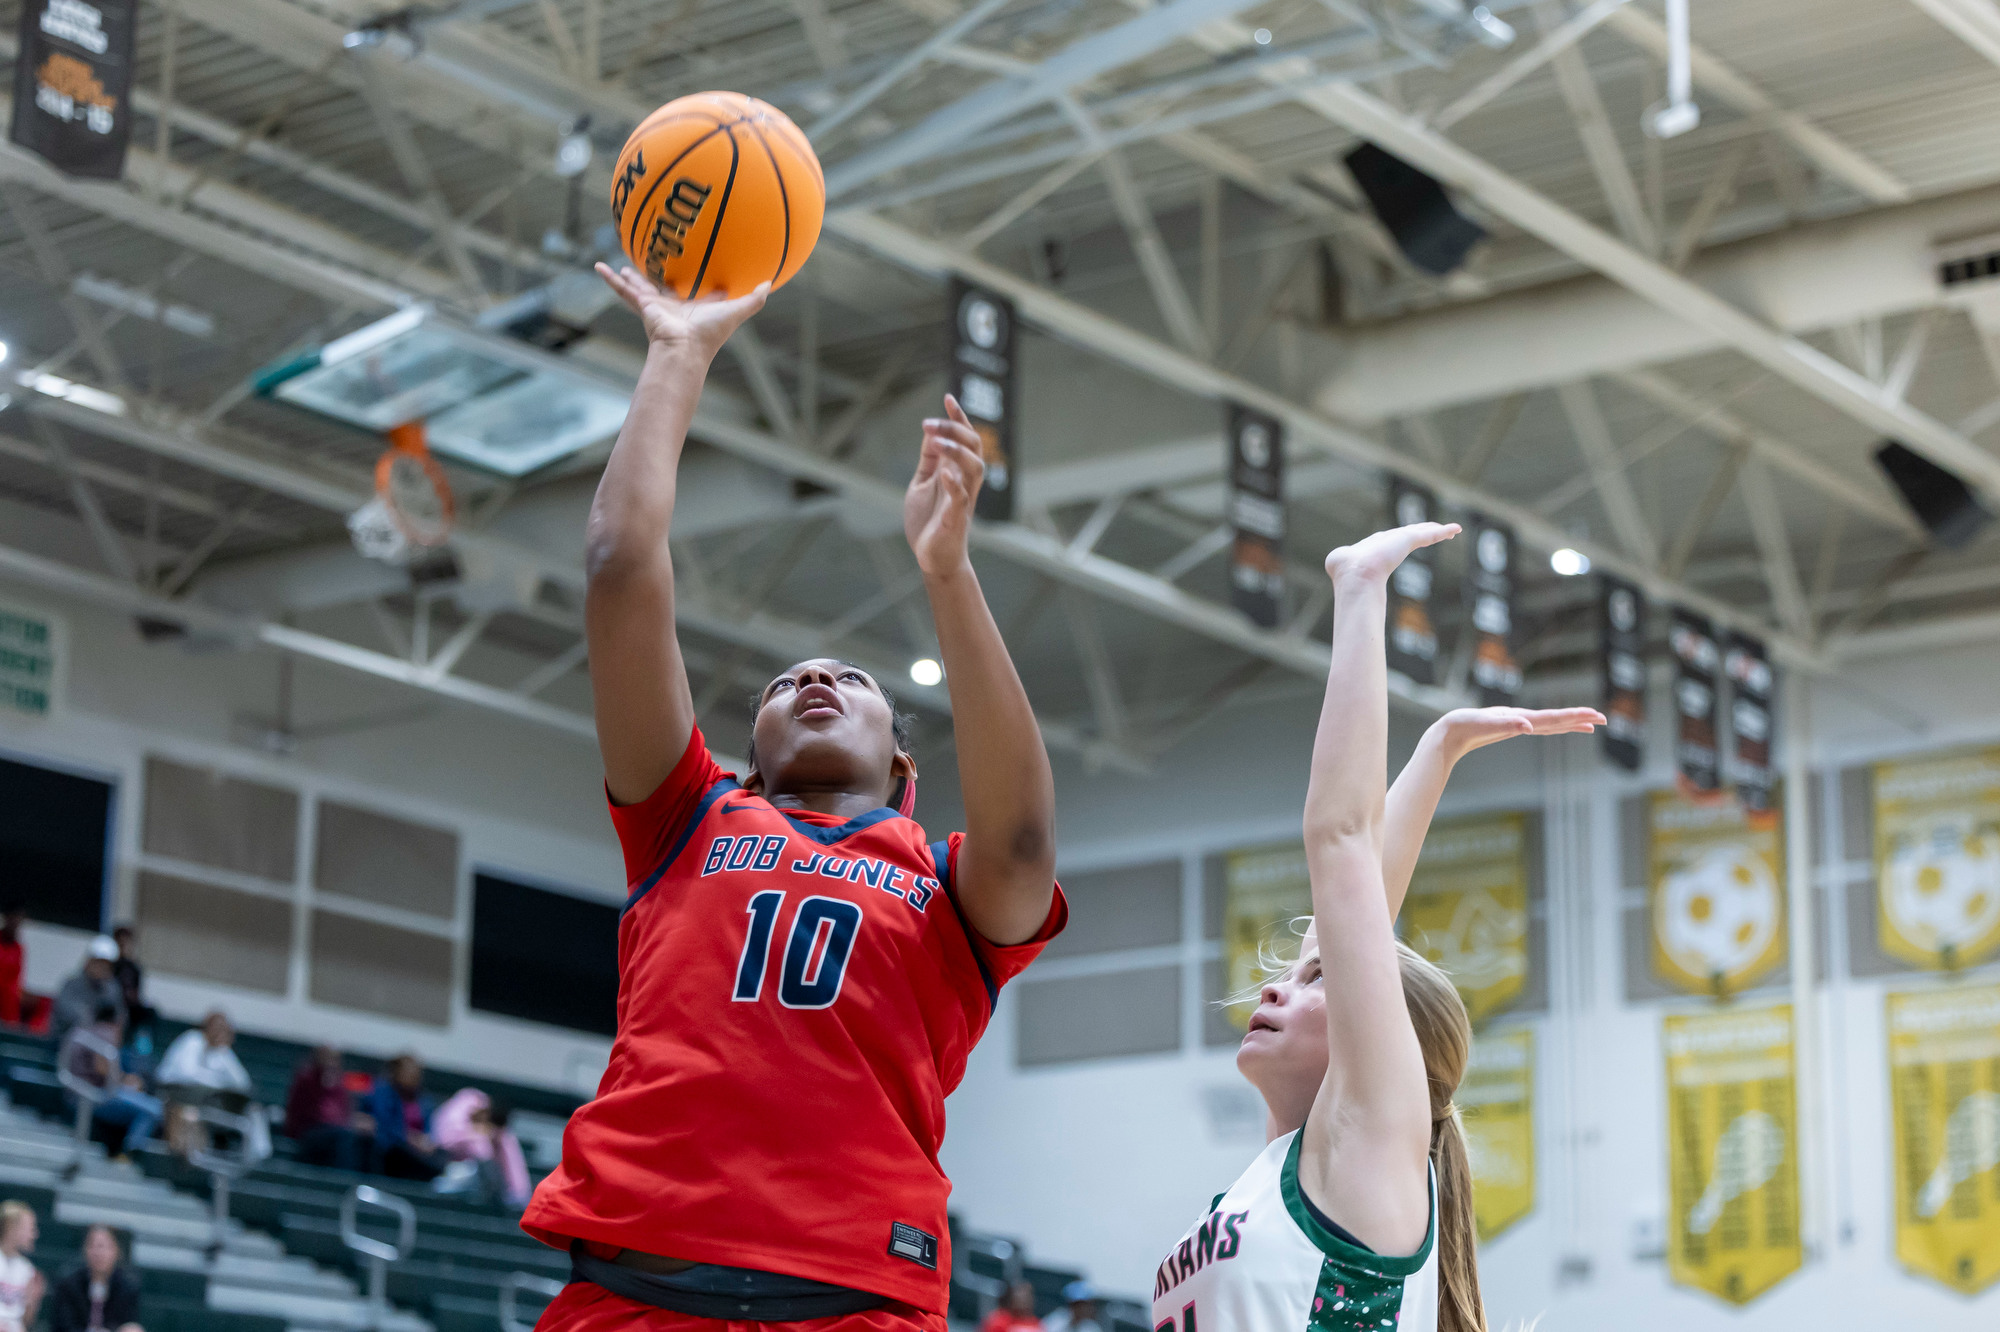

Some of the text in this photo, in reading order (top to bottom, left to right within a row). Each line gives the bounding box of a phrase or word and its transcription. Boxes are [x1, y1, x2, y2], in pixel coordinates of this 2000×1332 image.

[701, 834, 939, 913] BOB JONES
[731, 889, 863, 1009] 10
